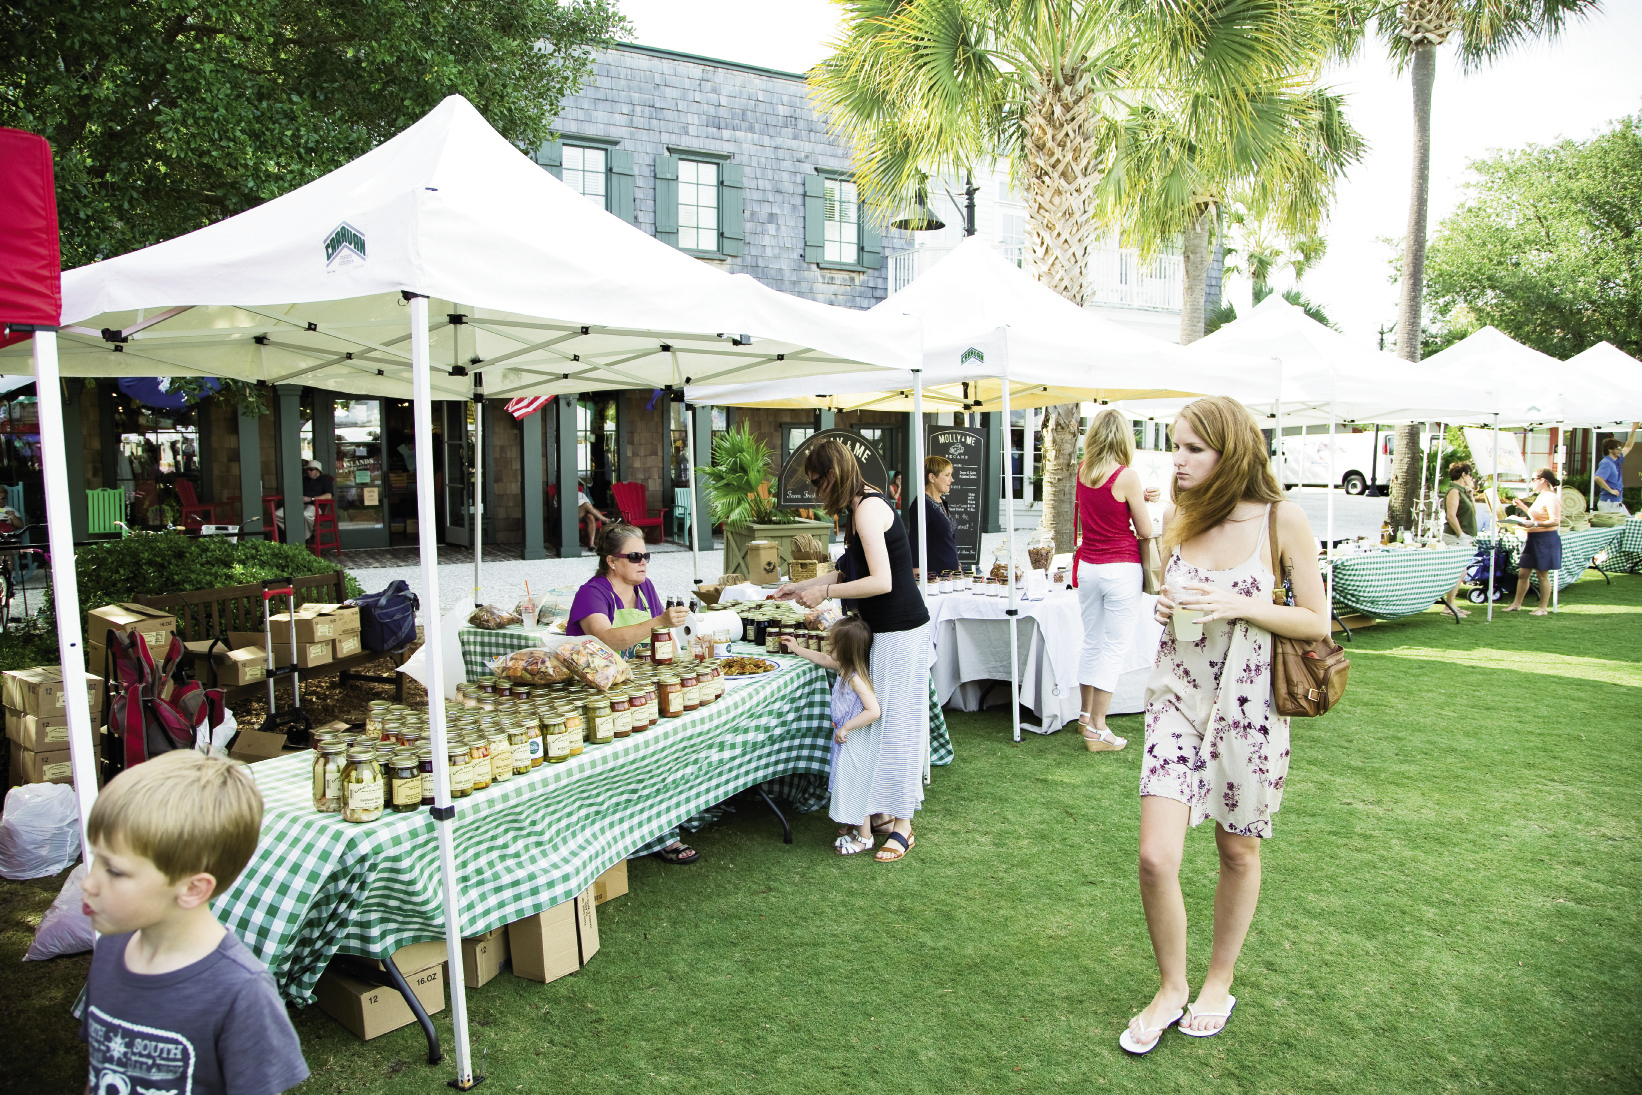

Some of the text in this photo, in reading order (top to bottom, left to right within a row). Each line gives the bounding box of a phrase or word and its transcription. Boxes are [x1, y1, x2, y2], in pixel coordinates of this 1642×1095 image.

[325, 225, 366, 261] CARAVAN
[938, 434, 961, 443] MOLLY
[966, 435, 976, 446] ME
[853, 442, 871, 463] ME
[45, 687, 53, 695] 12
[416, 973, 437, 986] 16.OZ
[368, 994, 378, 1004] 12
[133, 1038, 183, 1058] SOUTH
